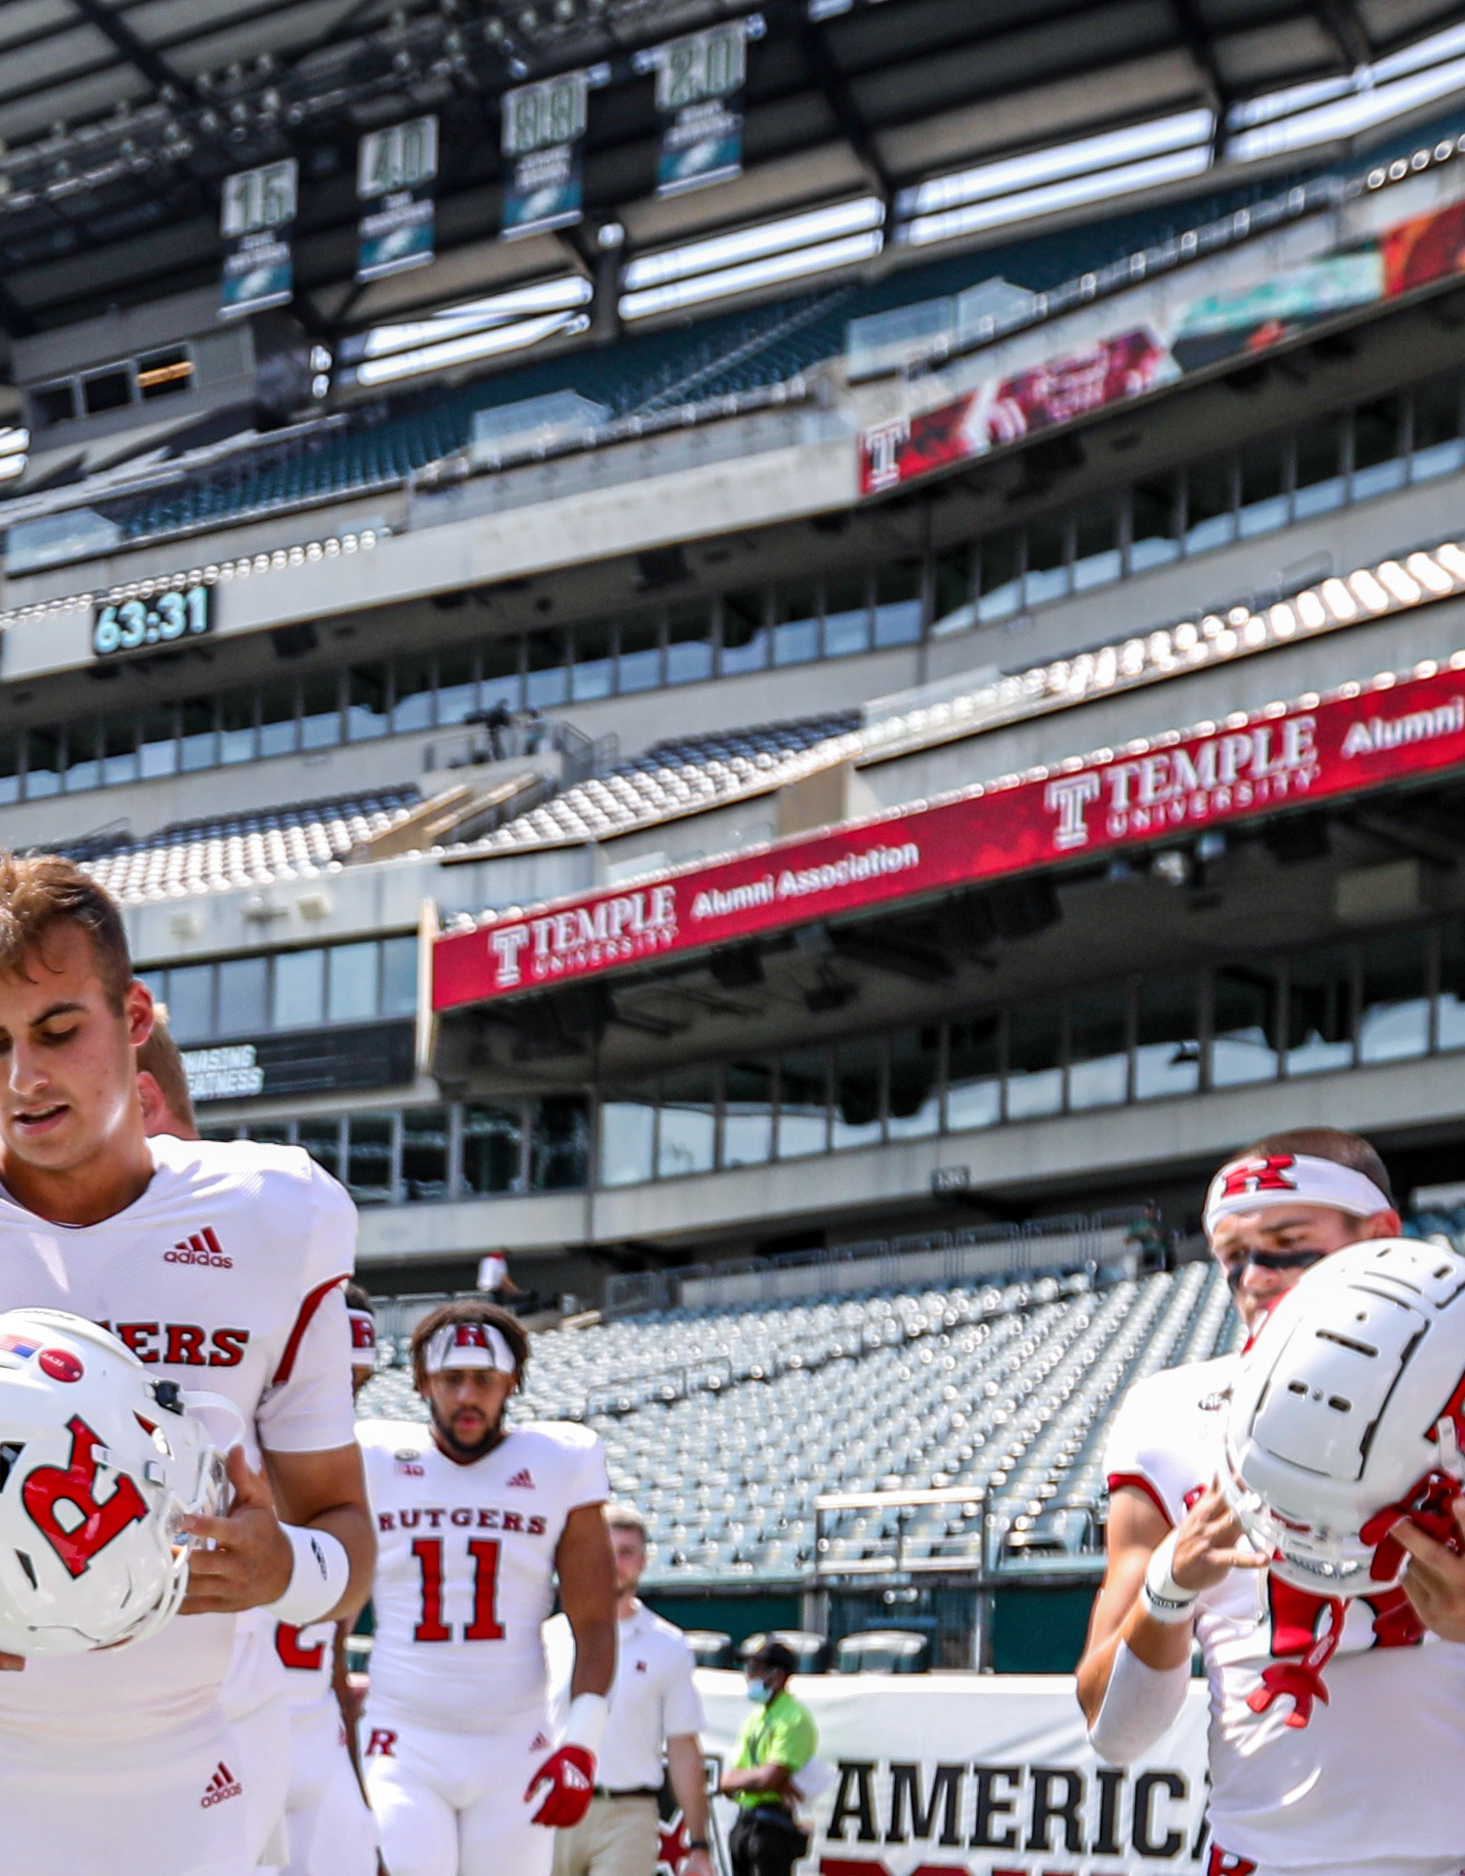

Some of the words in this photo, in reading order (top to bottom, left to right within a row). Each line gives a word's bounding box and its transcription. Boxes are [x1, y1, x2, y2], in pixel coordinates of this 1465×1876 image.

[95, 587, 208, 654] 63:31
[1341, 697, 1465, 757] Alumni
[1105, 714, 1319, 812] TEMPLE
[1045, 773, 1101, 851] T
[1106, 764, 1321, 837] UNIVERSITY
[691, 875, 774, 922] Alumni
[777, 842, 920, 898] Association
[530, 885, 676, 957] TEMPLE
[532, 925, 679, 979] UNIVERSITY
[489, 924, 530, 987] T
[1219, 1153, 1298, 1198] R
[163, 1248, 233, 1270] adidas
[22, 1413, 151, 1581] R
[377, 1507, 548, 1537] RUTGERS
[411, 1538, 505, 1643] 11
[364, 1729, 398, 1757] R
[201, 1782, 244, 1809] adidas
[827, 1760, 1207, 1860] AMERIC
